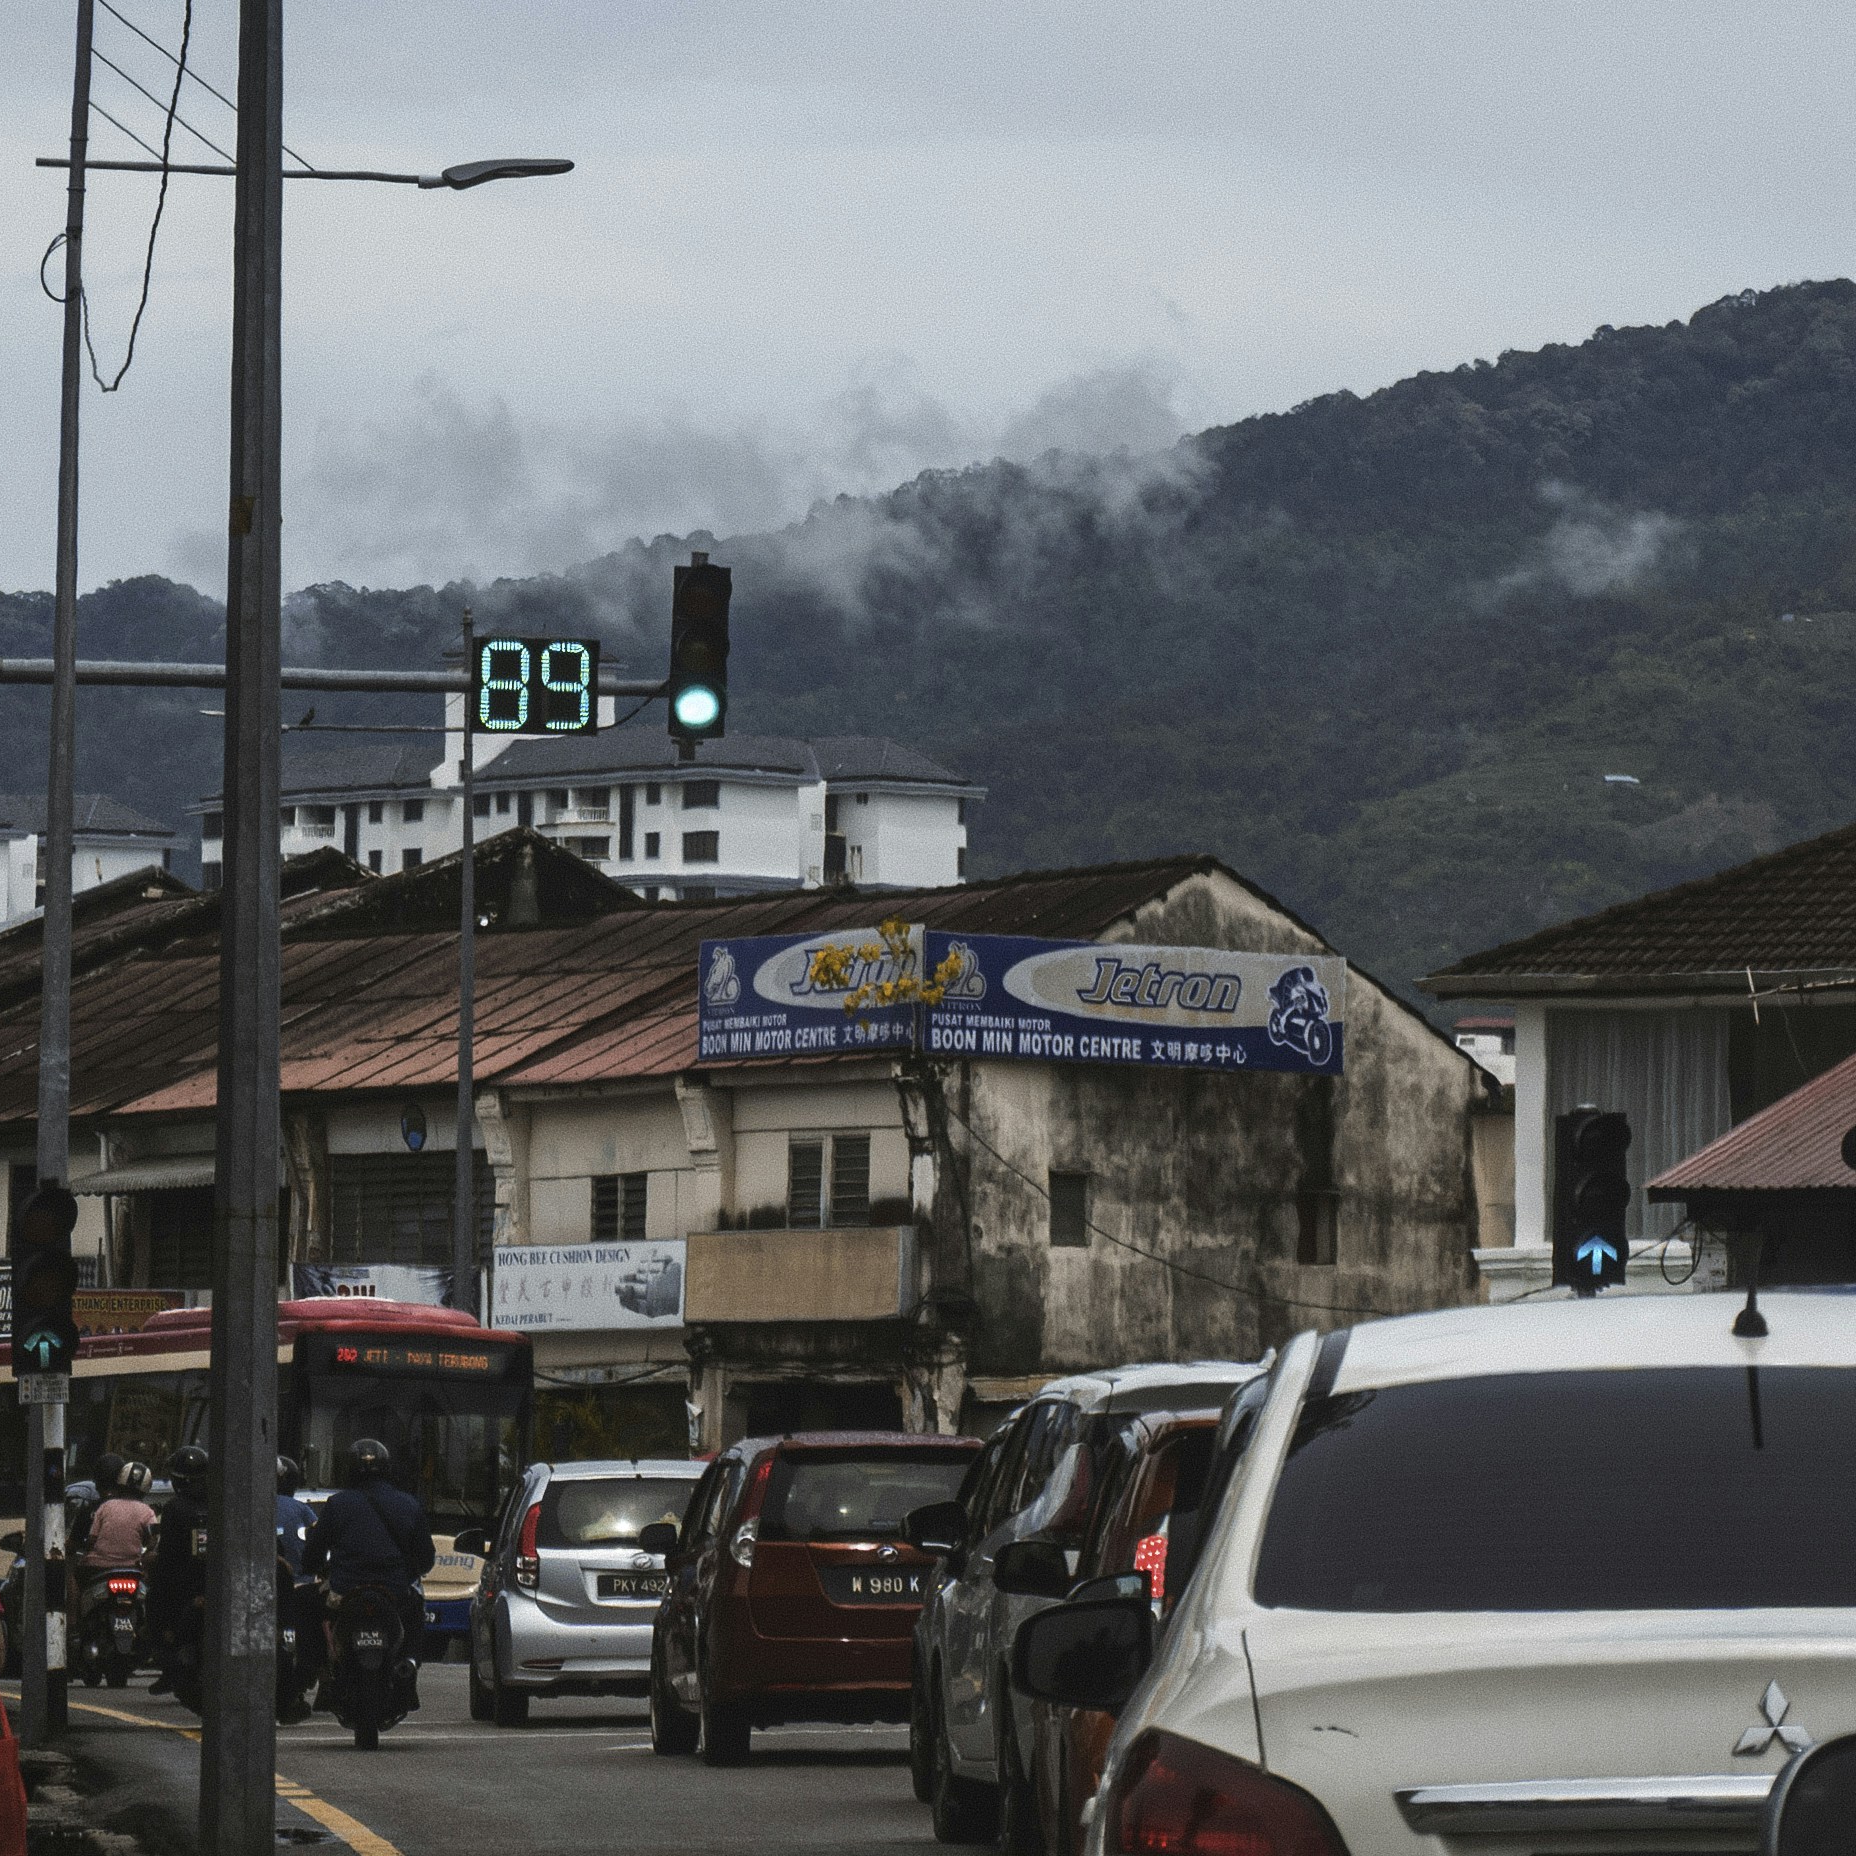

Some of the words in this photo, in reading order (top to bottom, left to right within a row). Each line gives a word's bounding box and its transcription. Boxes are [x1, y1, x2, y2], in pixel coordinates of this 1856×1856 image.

[479, 640, 590, 731] 89
[1076, 958, 1242, 1013] Jetron
[762, 1013, 787, 1027] MOTOR
[931, 1013, 963, 1027] PUSAT
[965, 1014, 1015, 1029] MEMBAIKI
[1018, 1018, 1052, 1032] MOTOR
[702, 1033, 727, 1055] BOON
[730, 1031, 752, 1053] MIN
[755, 1028, 792, 1051] MOTOR
[794, 1025, 836, 1049] CENTRE
[931, 1027, 977, 1051] BOON
[982, 1030, 1013, 1053] MIN
[1018, 1032, 1075, 1057] MOTOR
[1079, 1035, 1142, 1060] CENTRE
[497, 1251, 528, 1267] HONG
[529, 1250, 547, 1265] BEE
[549, 1248, 593, 1265] CUSHION
[595, 1247, 631, 1264] DESIGN
[613, 1578, 637, 1593] PKY
[640, 1578, 665, 1593] 492
[869, 1577, 903, 1594] 980
[910, 1576, 920, 1593] K
